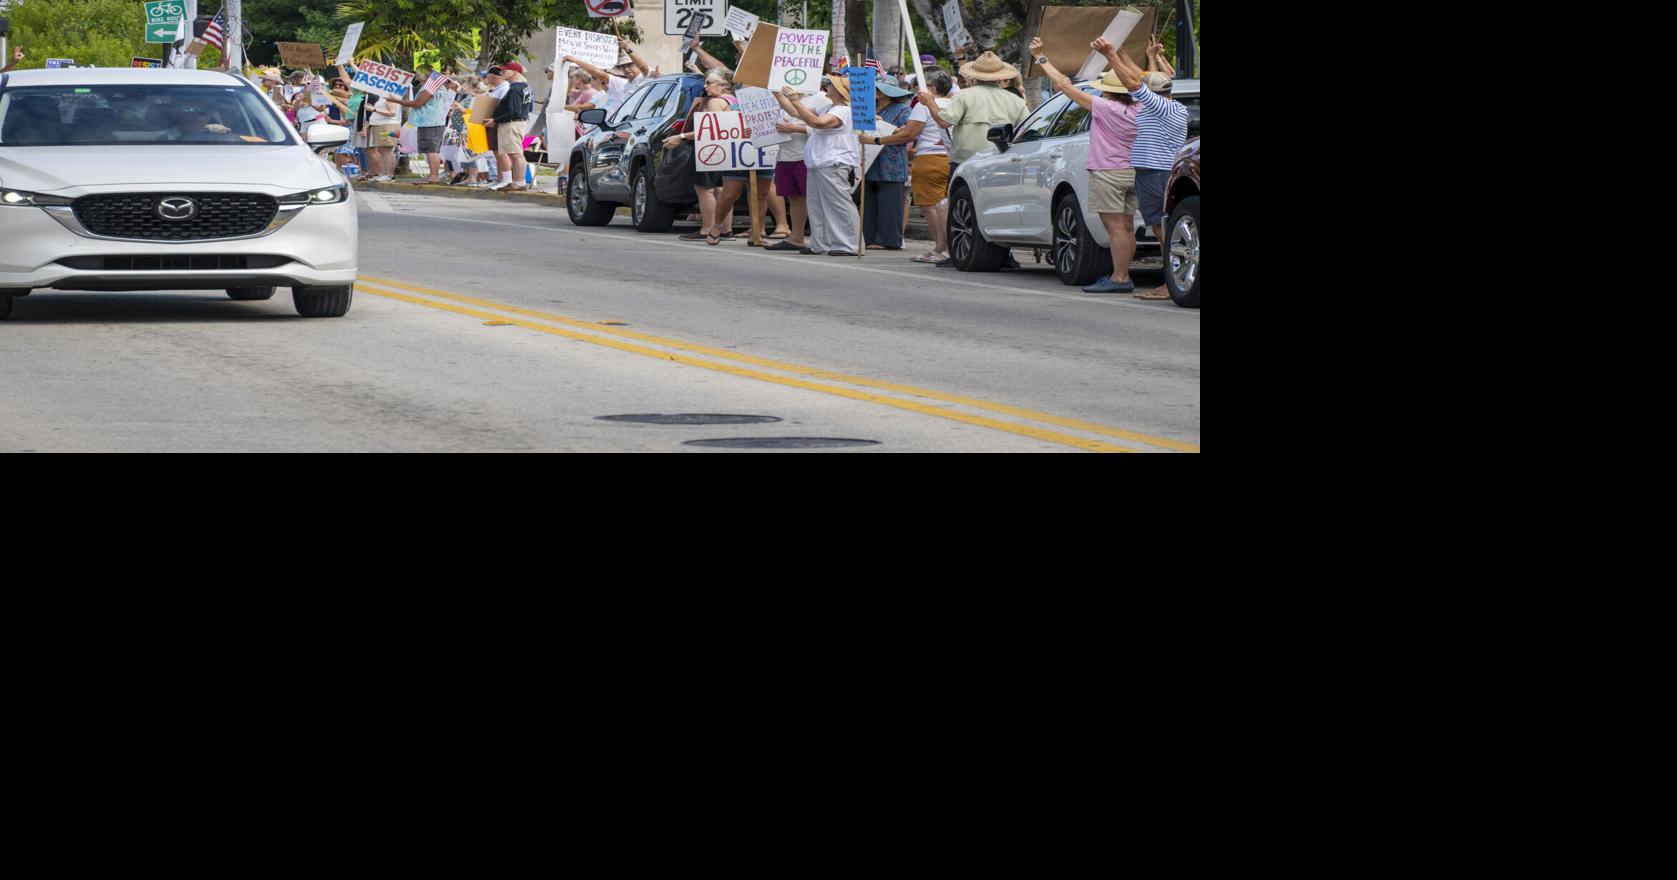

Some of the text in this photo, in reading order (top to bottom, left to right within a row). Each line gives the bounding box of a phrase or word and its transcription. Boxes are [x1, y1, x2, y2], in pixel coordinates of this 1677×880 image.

[676, 8, 714, 29] 25
[558, 27, 617, 46] EVERY DISASTER
[779, 32, 825, 44] POWER
[781, 43, 822, 55] TO THE
[132, 60, 161, 68] RESIST
[774, 55, 822, 69] PEACEFUL
[360, 59, 413, 85] RESIST
[353, 70, 408, 96] FASCISM
[740, 97, 779, 113] PEACEFUL
[744, 109, 782, 125] PROTEST
[697, 112, 745, 141] Abol
[731, 141, 773, 168] ICE
